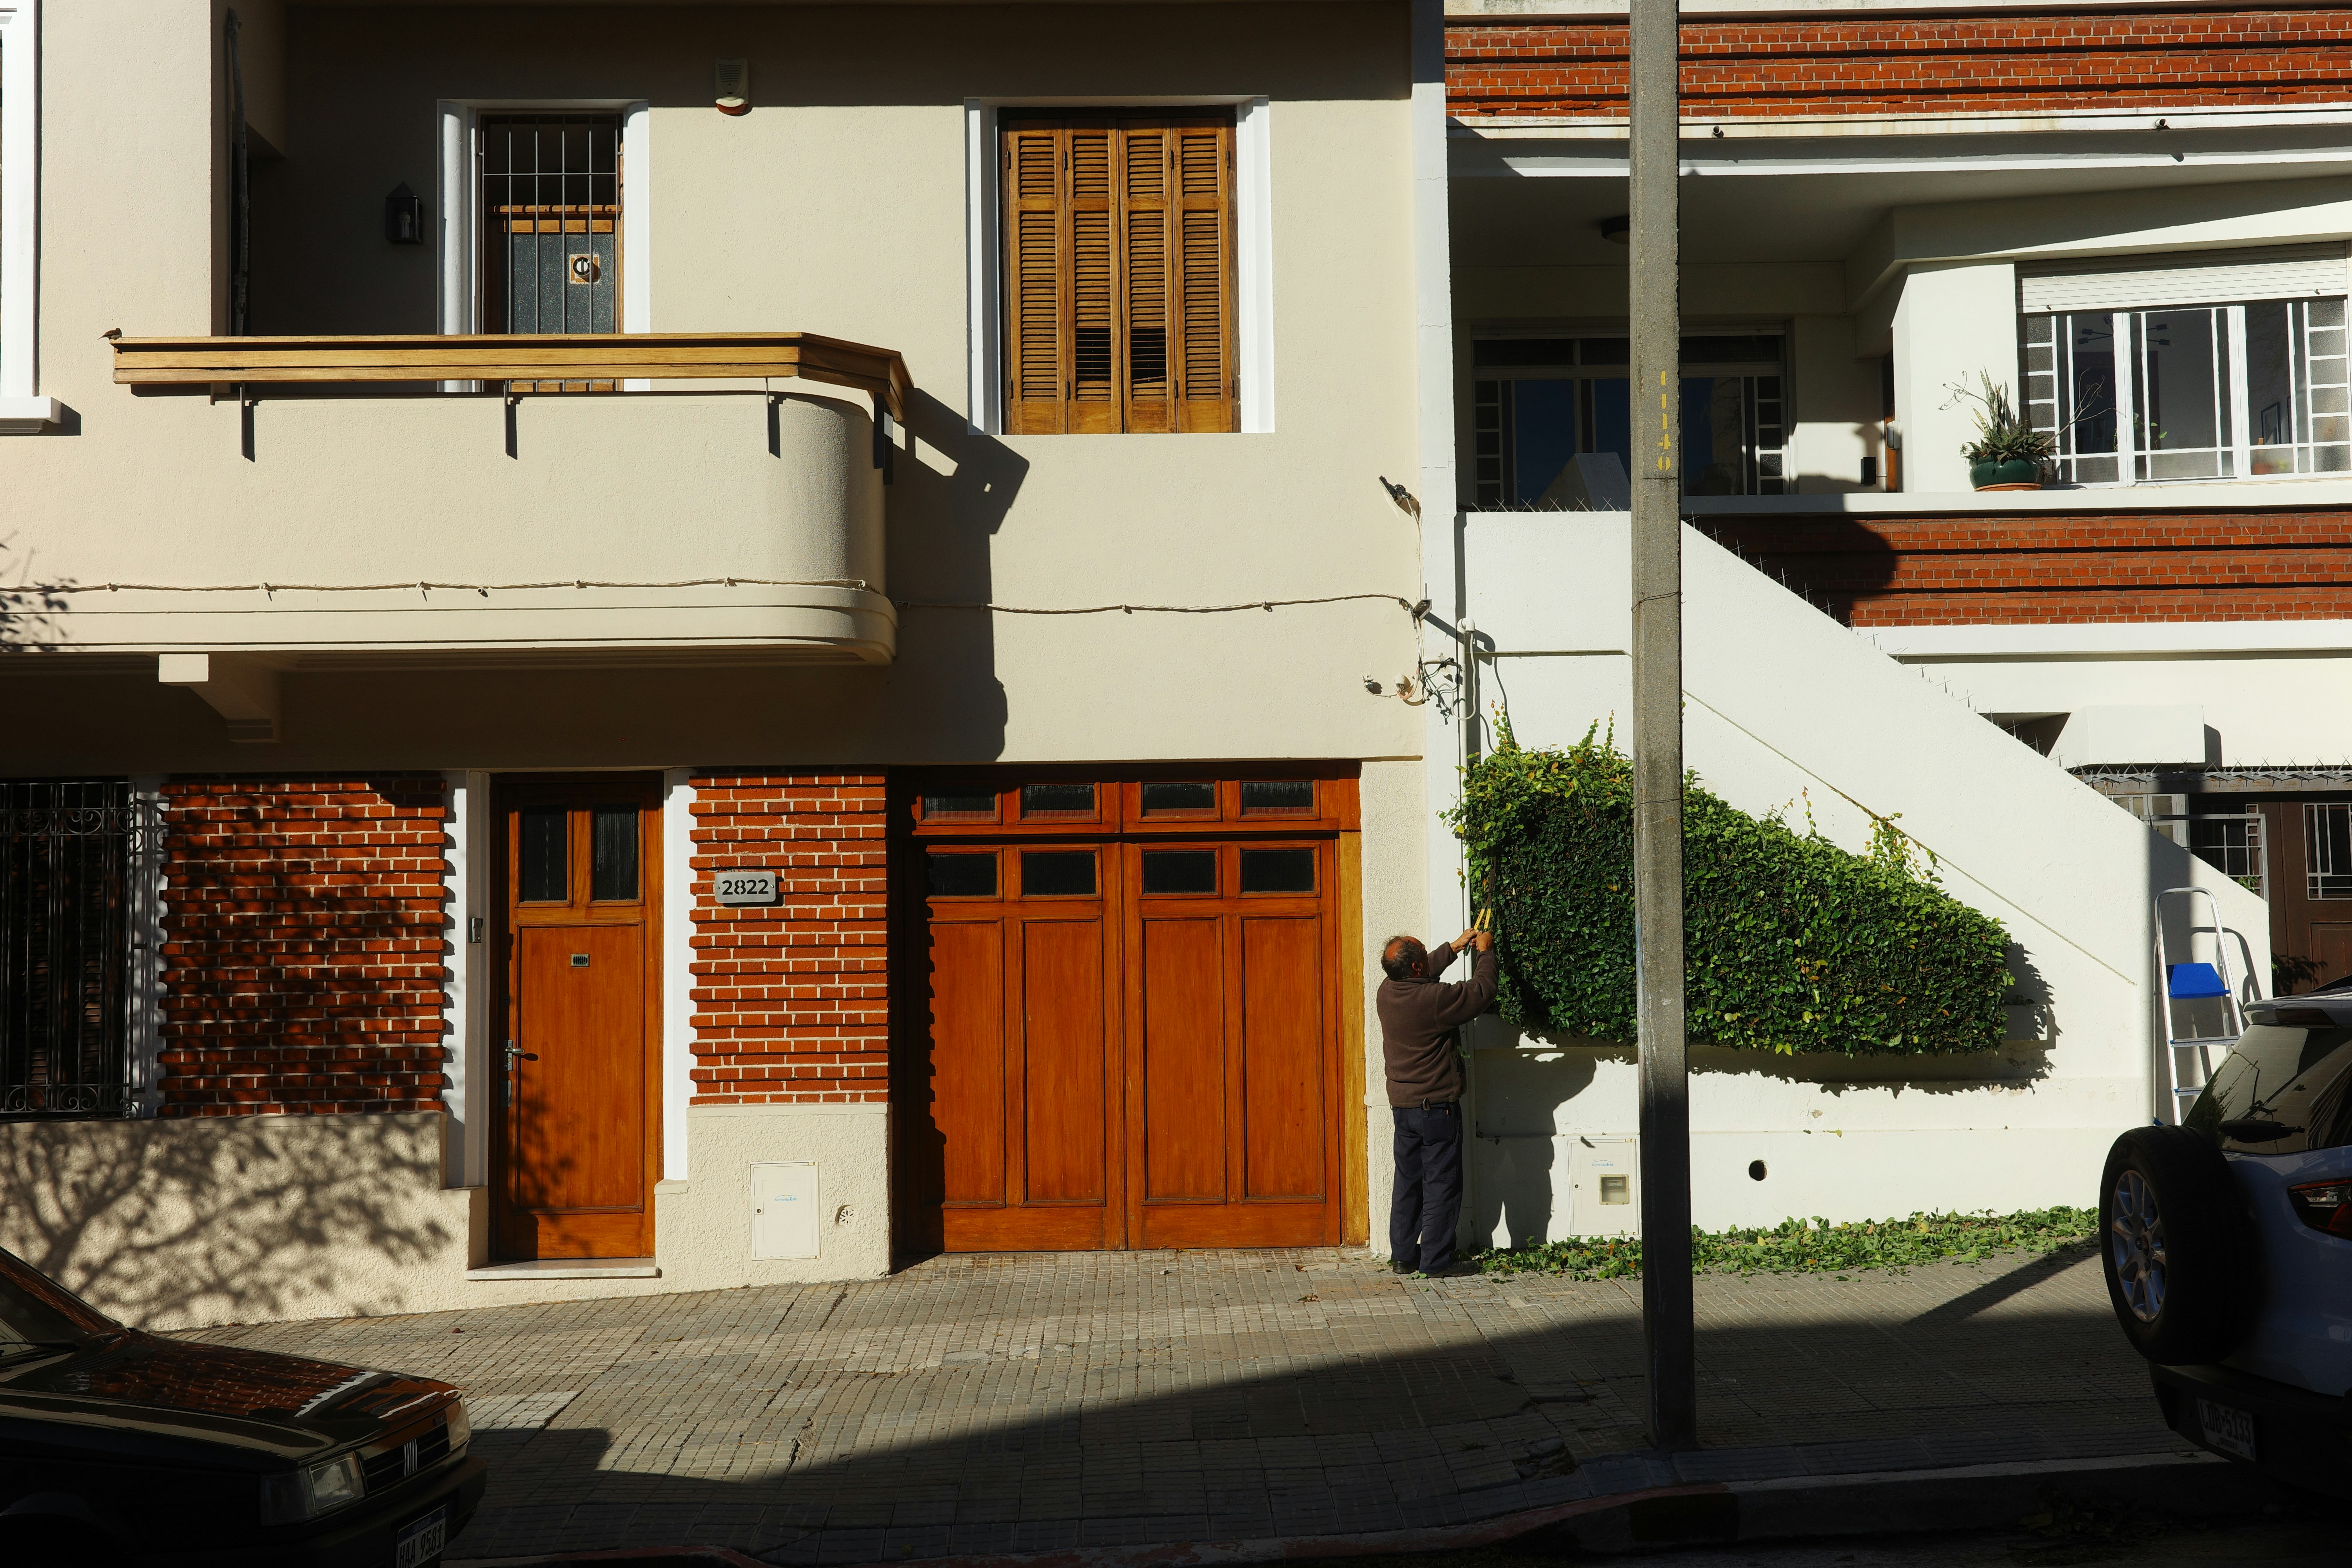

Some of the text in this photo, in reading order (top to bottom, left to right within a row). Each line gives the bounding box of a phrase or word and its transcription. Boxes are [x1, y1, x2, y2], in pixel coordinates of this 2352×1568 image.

[722, 879, 769, 895] 2822
[413, 1516, 432, 1533] URUGUAY
[399, 1523, 443, 1568] HAA 9581
